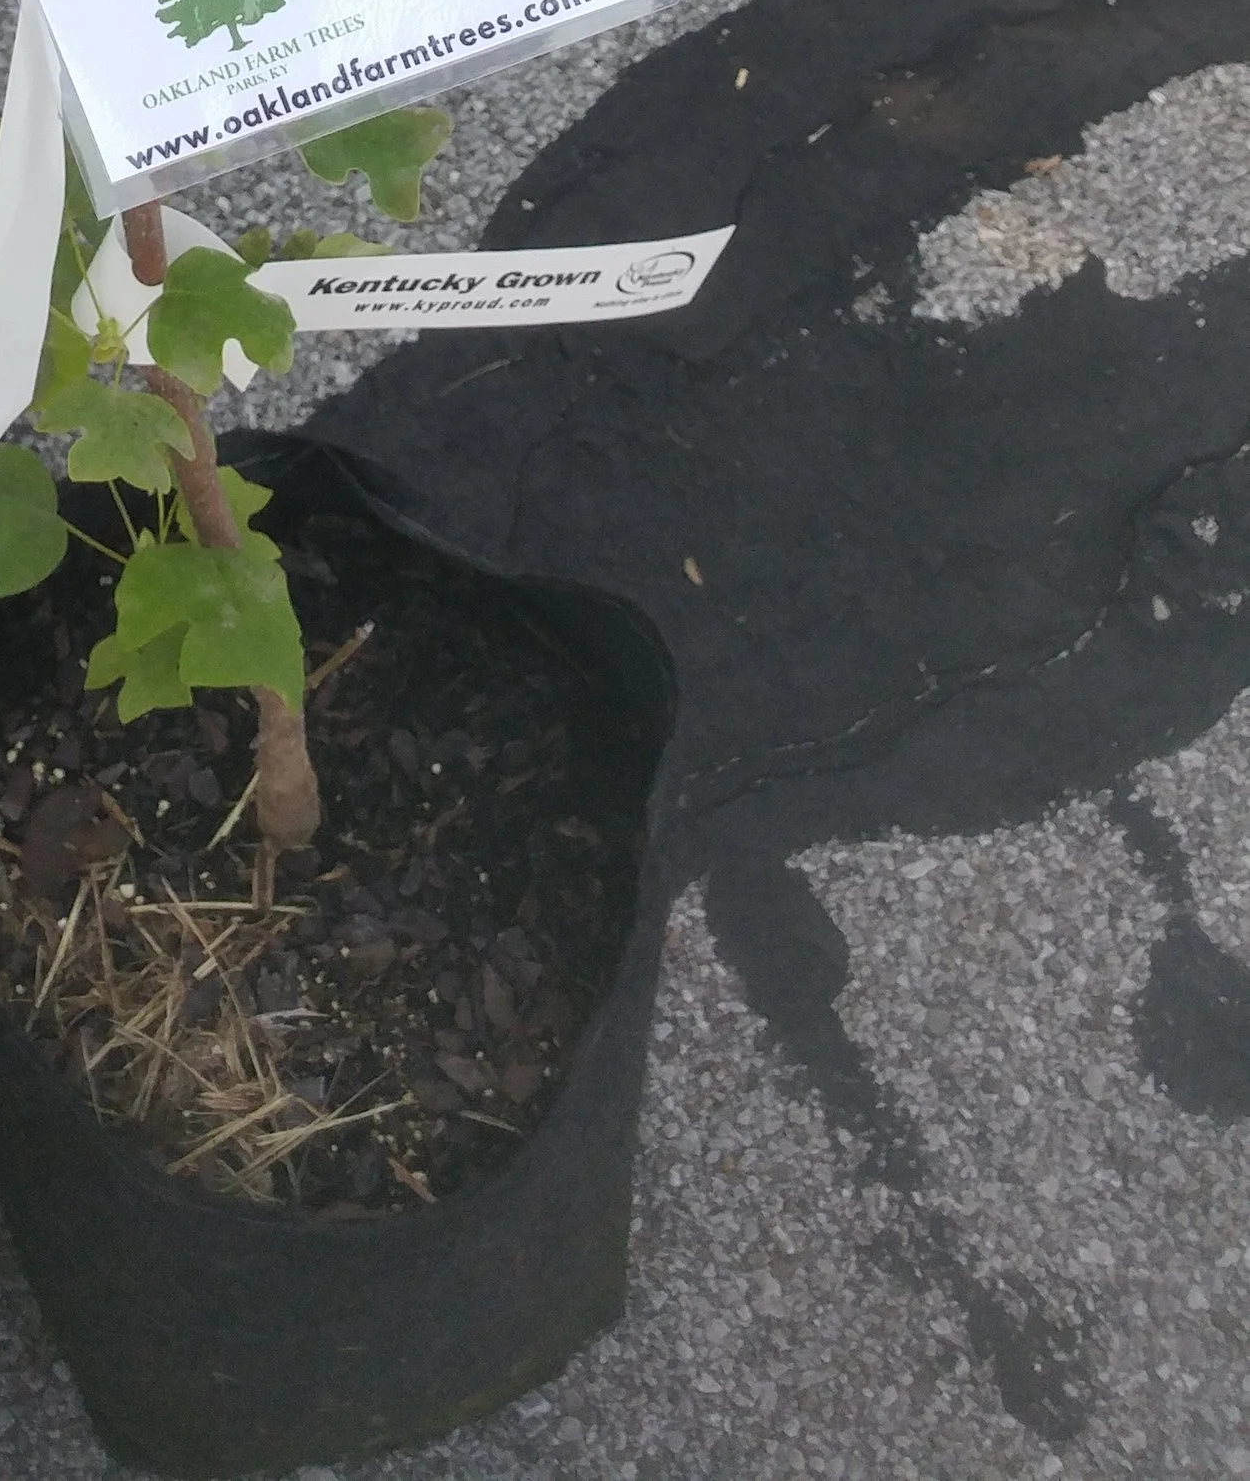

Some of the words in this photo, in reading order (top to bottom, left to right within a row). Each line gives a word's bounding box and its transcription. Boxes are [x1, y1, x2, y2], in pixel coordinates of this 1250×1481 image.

[143, 62, 240, 109] OAKLAND
[244, 38, 302, 71] FARM
[304, 14, 365, 47] TREES
[226, 75, 268, 95] PARIS,
[269, 65, 288, 79] KY
[308, 274, 486, 296] Kentucky
[496, 271, 601, 289] Grown
[353, 295, 552, 313] www.kyproud.com
